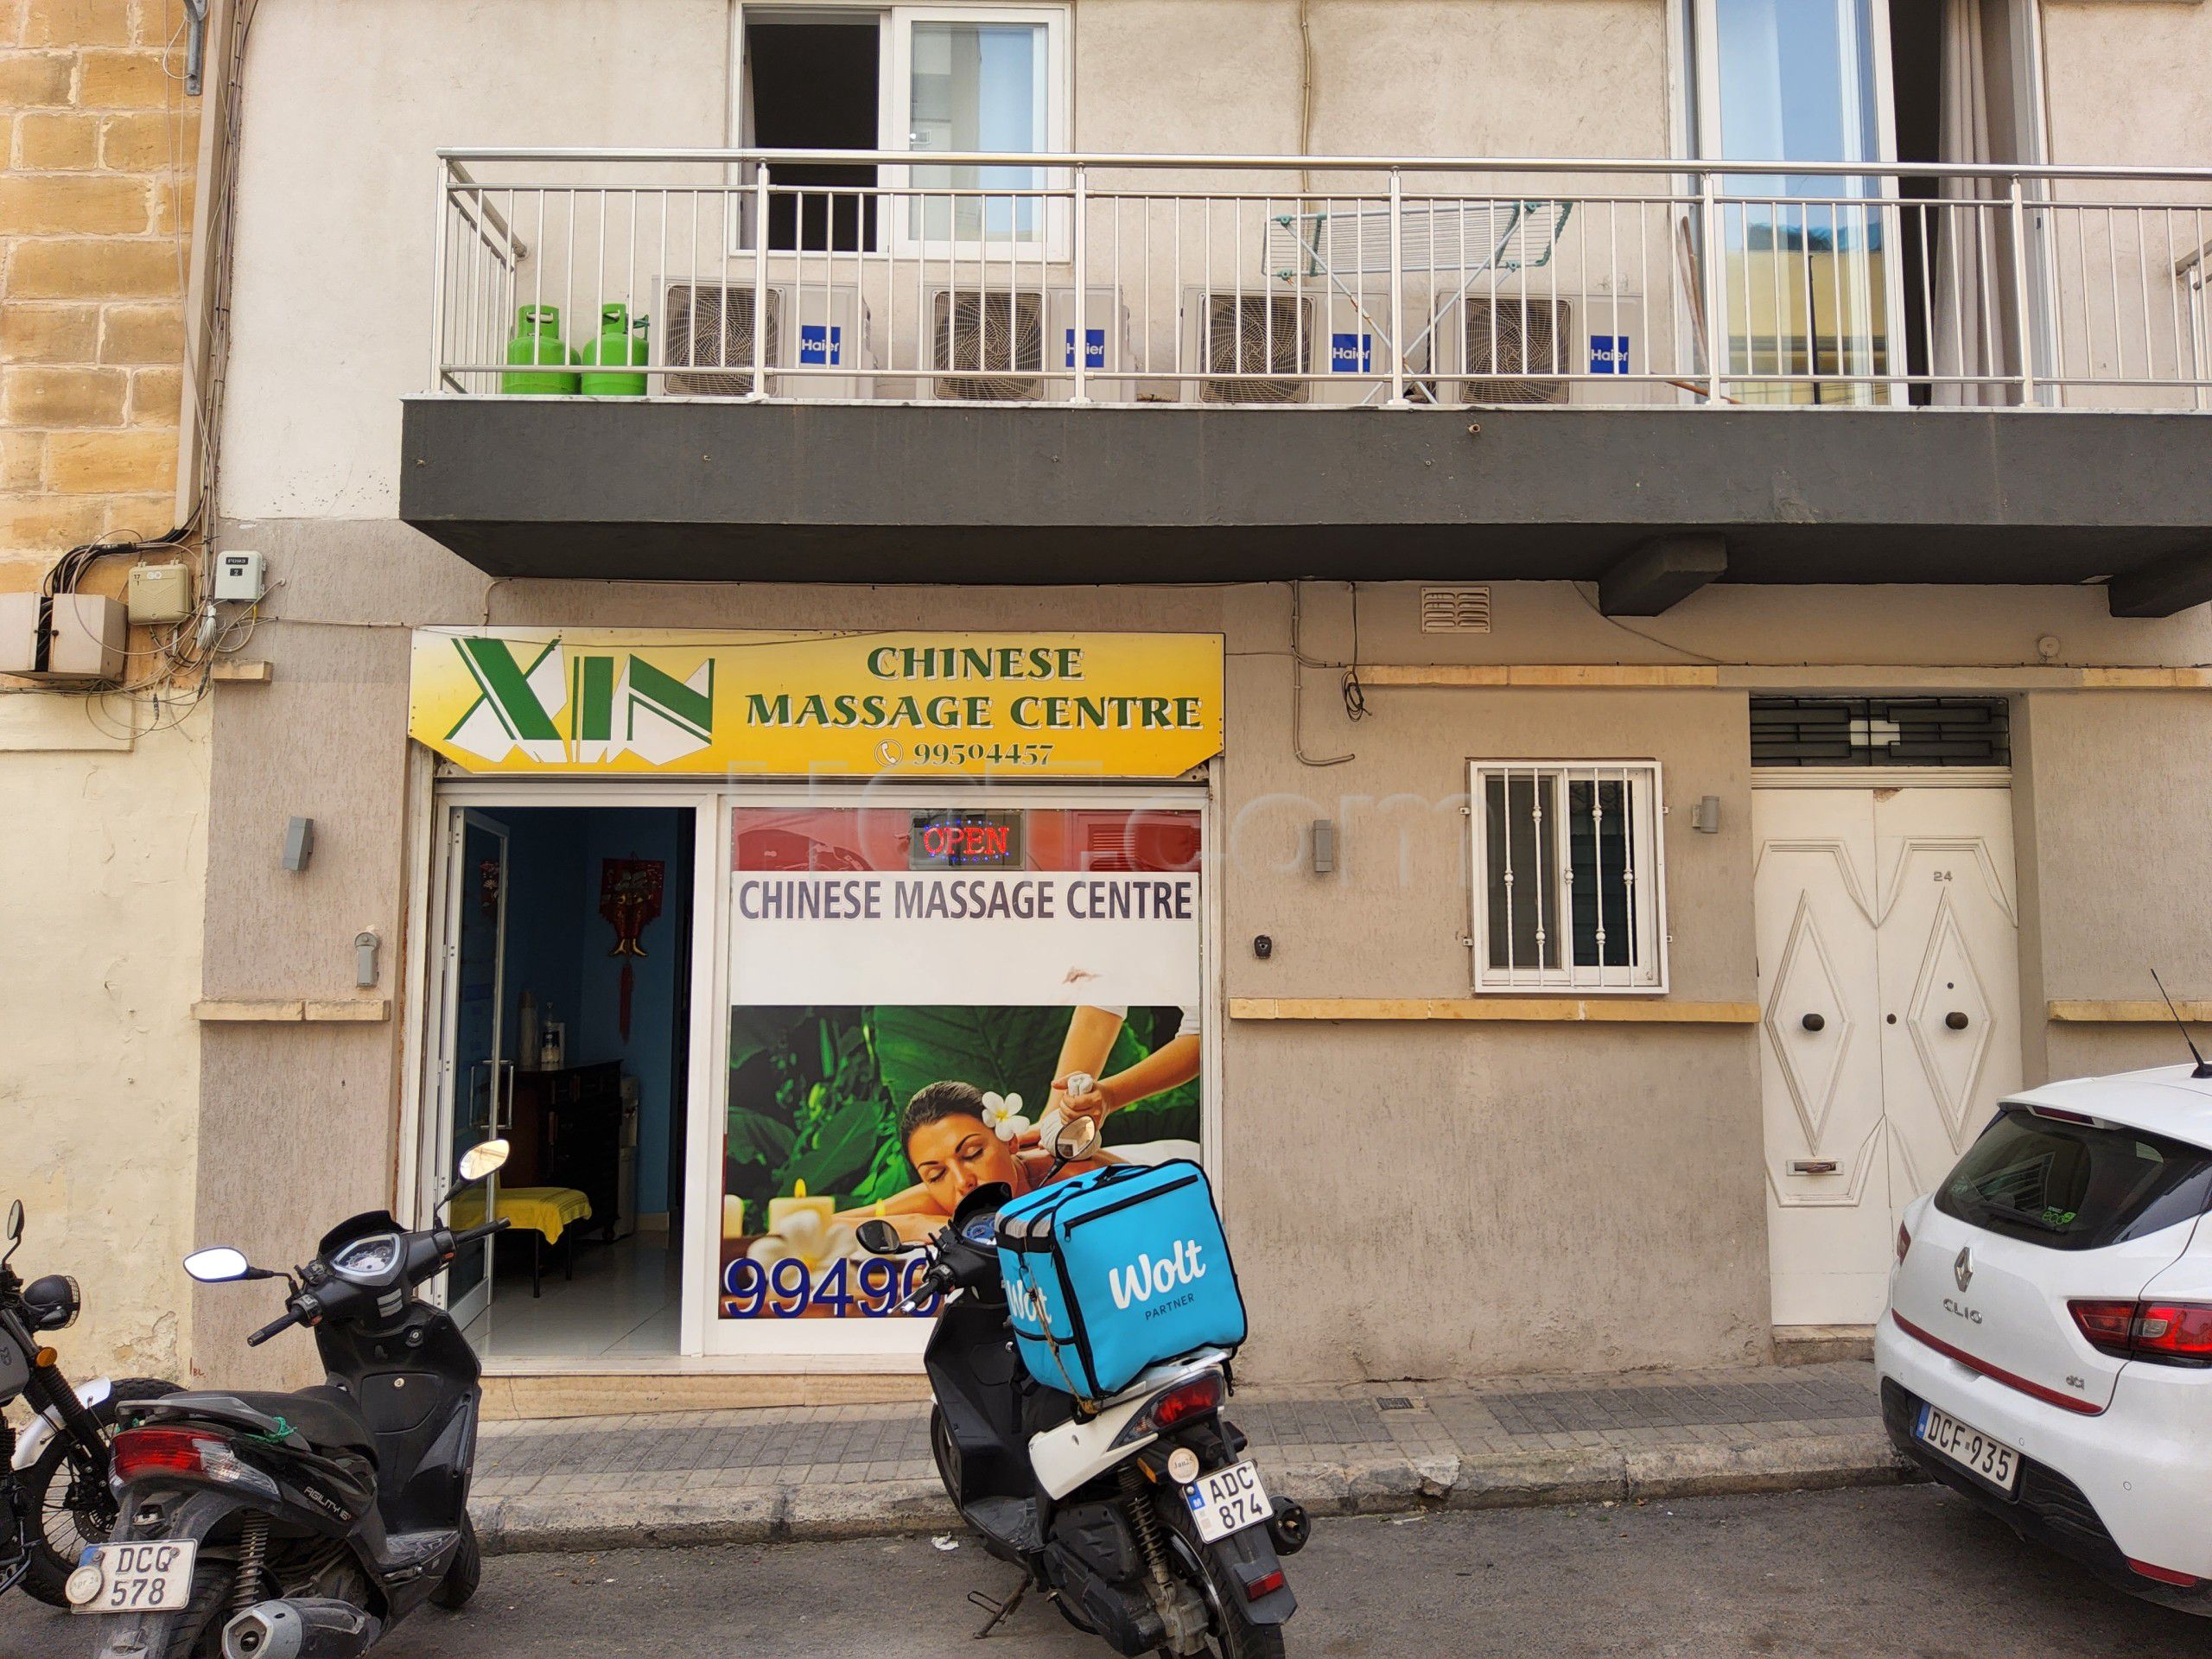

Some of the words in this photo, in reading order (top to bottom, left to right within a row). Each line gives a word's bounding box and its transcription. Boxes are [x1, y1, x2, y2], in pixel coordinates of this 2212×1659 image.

[1066, 343, 1103, 355] Hier
[867, 646, 1085, 681] CHINESE
[443, 638, 715, 747] XIN
[746, 694, 995, 730] MASSAGE
[1009, 696, 1205, 731] CENTRE
[913, 743, 1054, 766] 99504457
[924, 827, 1009, 855] OPEN
[1934, 871, 1953, 881] 24
[739, 880, 881, 920] CHINESE
[894, 880, 1054, 920] MASSAGE
[1066, 880, 1193, 919] CENTRE
[724, 1257, 947, 1319] 99490
[1109, 1239, 1206, 1310] Wolt
[1007, 1280, 1052, 1324] Wot
[1145, 1293, 1195, 1321] PARTNER
[1943, 1299, 1983, 1324] CLIO
[304, 1486, 341, 1513] AGILITY
[1210, 1466, 1254, 1503] ADC
[1218, 1493, 1263, 1529] 874
[116, 1547, 172, 1575] DCQ
[111, 1578, 165, 1606] 578
